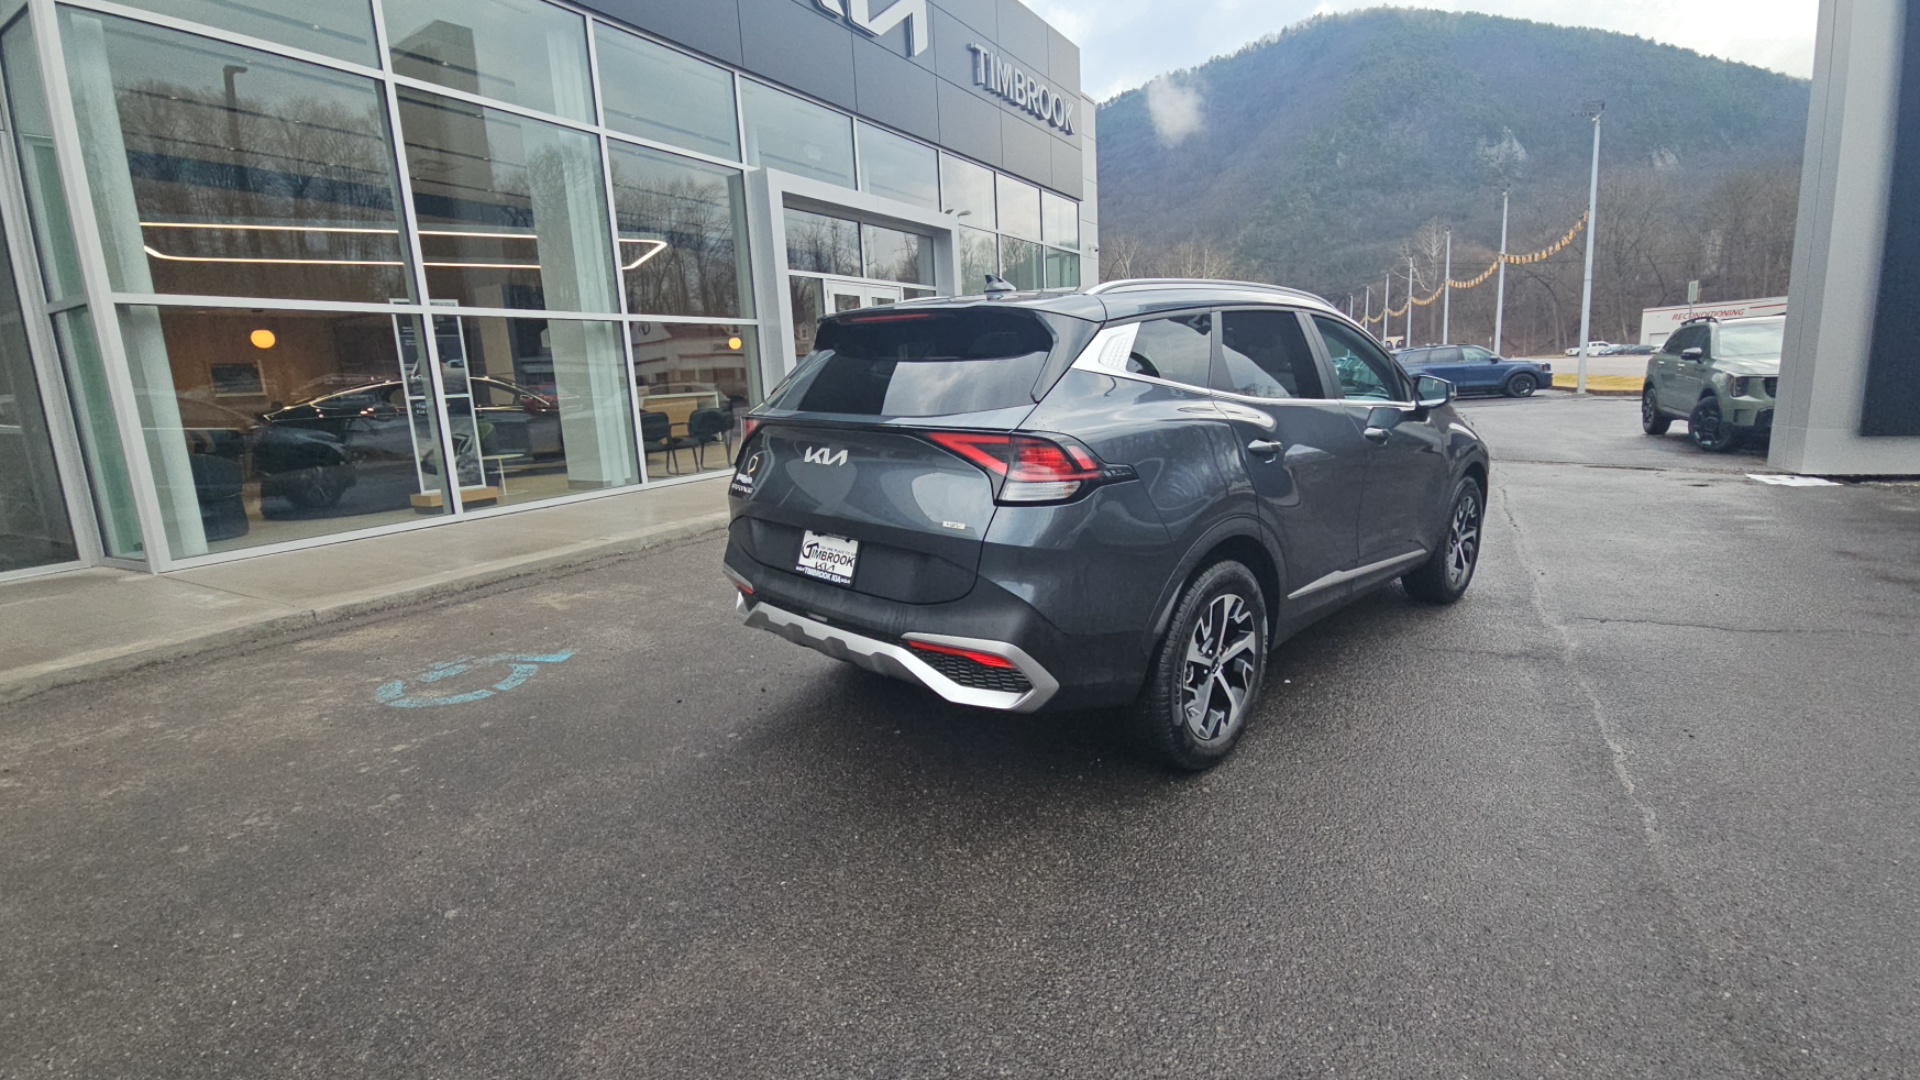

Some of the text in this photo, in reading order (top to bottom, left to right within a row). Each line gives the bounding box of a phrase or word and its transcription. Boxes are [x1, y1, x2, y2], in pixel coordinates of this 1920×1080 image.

[970, 42, 1075, 134] TIMBROOK
[804, 446, 848, 466] KIA
[802, 540, 855, 567] TIMBROOK
